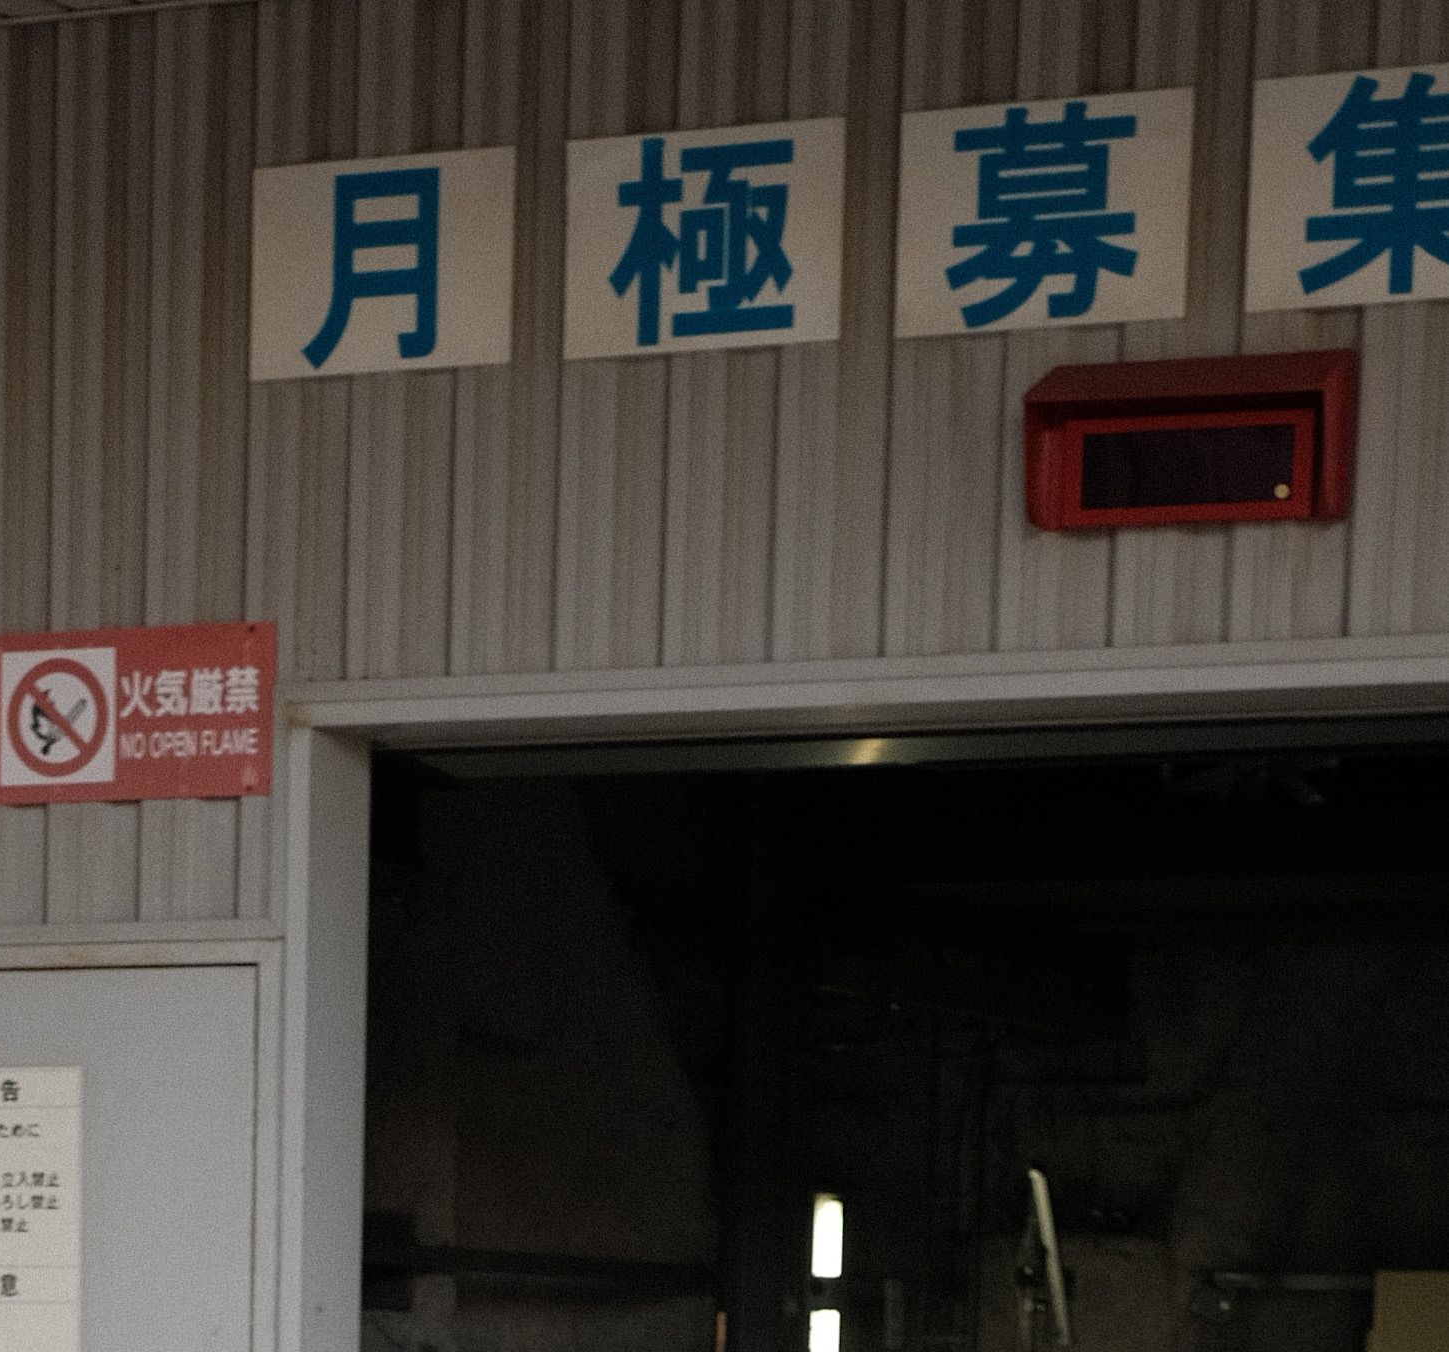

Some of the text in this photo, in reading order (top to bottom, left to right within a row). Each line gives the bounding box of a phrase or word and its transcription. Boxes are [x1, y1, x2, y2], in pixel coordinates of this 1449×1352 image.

[120, 667, 262, 718] 火気厳禁
[119, 728, 259, 760] NO OPEN FLAME
